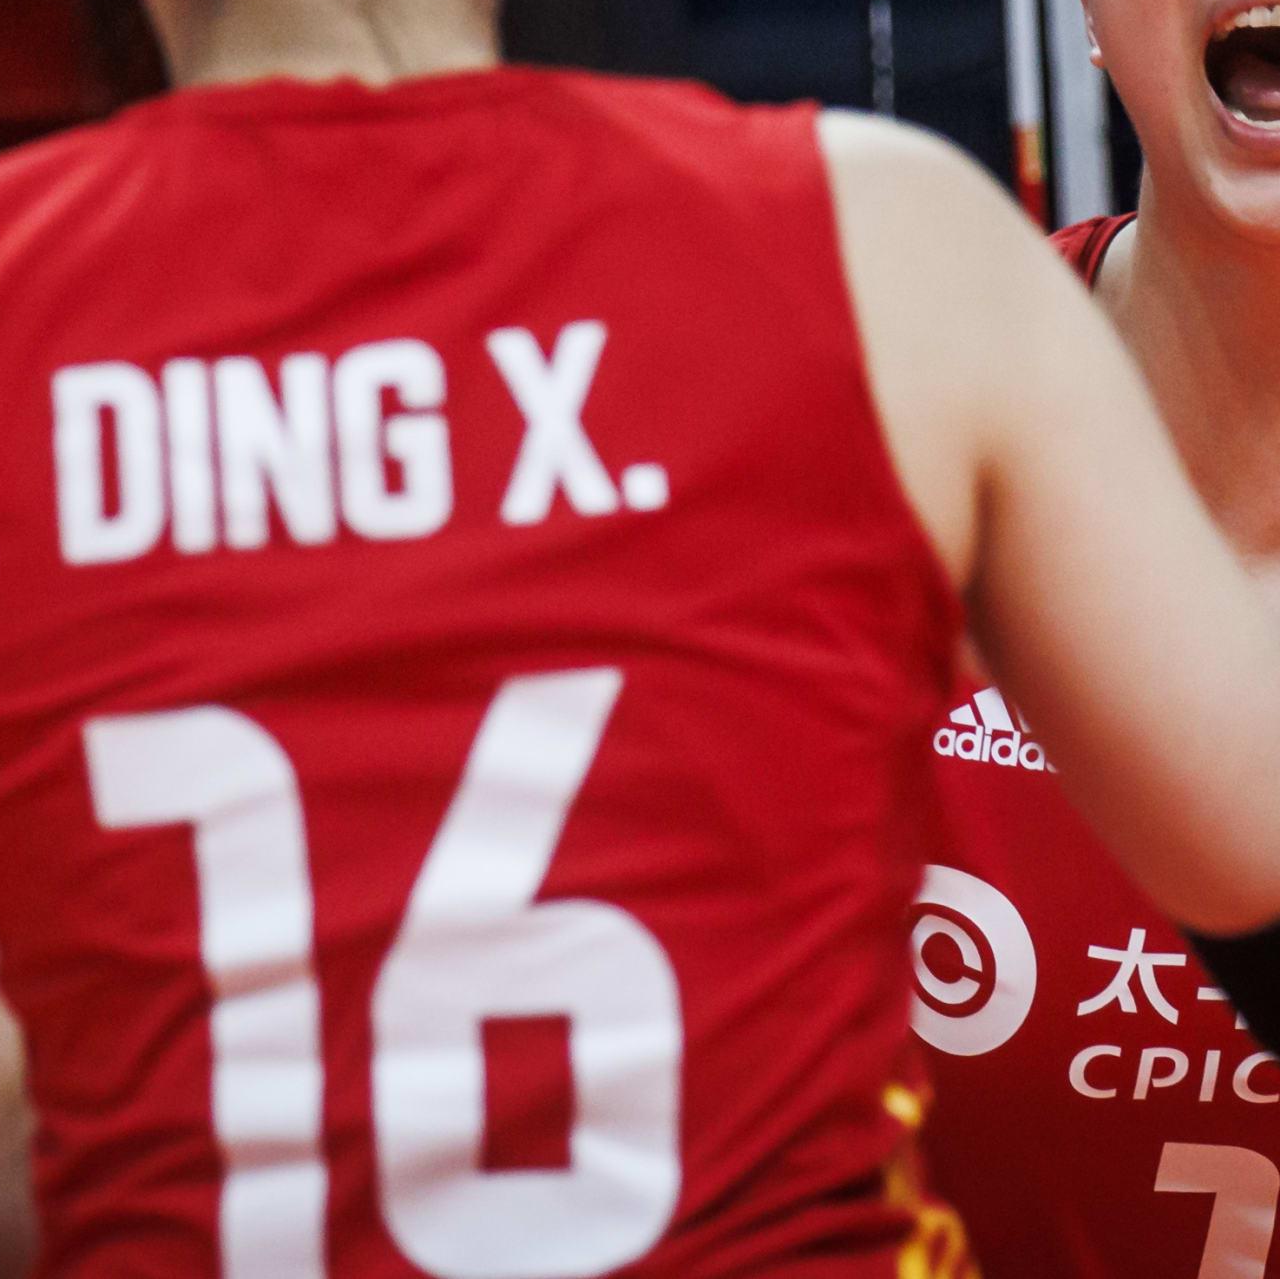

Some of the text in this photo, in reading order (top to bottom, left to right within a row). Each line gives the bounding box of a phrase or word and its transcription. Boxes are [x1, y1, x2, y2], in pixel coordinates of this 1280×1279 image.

[51, 320, 670, 568] DING X.
[932, 724, 1058, 773] adida
[82, 666, 685, 1279] 16
